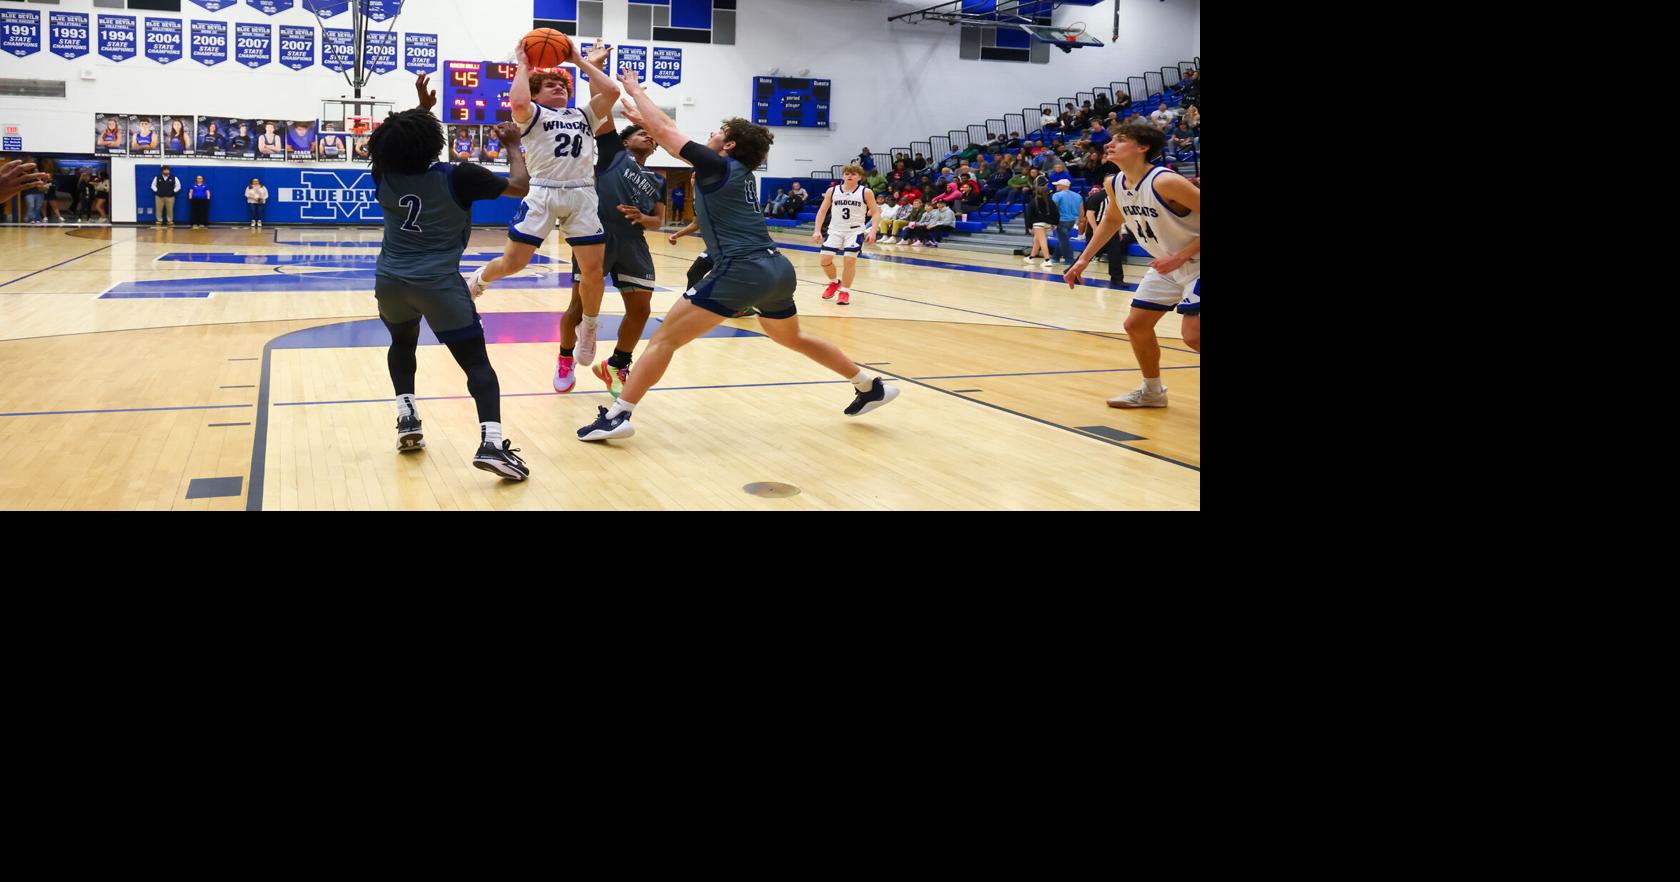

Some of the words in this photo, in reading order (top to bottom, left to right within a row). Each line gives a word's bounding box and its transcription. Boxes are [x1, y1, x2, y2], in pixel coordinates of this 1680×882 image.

[3, 25, 36, 36] 1991
[53, 27, 87, 39] 1993
[101, 31, 134, 41] 1994
[147, 33, 180, 44] 2004
[193, 35, 225, 46] 2006
[237, 38, 269, 48] 2007
[281, 40, 312, 51] 2007
[366, 45, 395, 55] 2008
[407, 47, 435, 57] 2008
[619, 61, 645, 70] 2019
[654, 61, 680, 70] 2019
[455, 71, 478, 88] 45
[460, 108, 469, 120] 3
[554, 133, 583, 159] 20
[292, 189, 337, 201] BLUE
[342, 189, 377, 201] DEV
[399, 194, 423, 233] 2
[842, 208, 850, 220] 3
